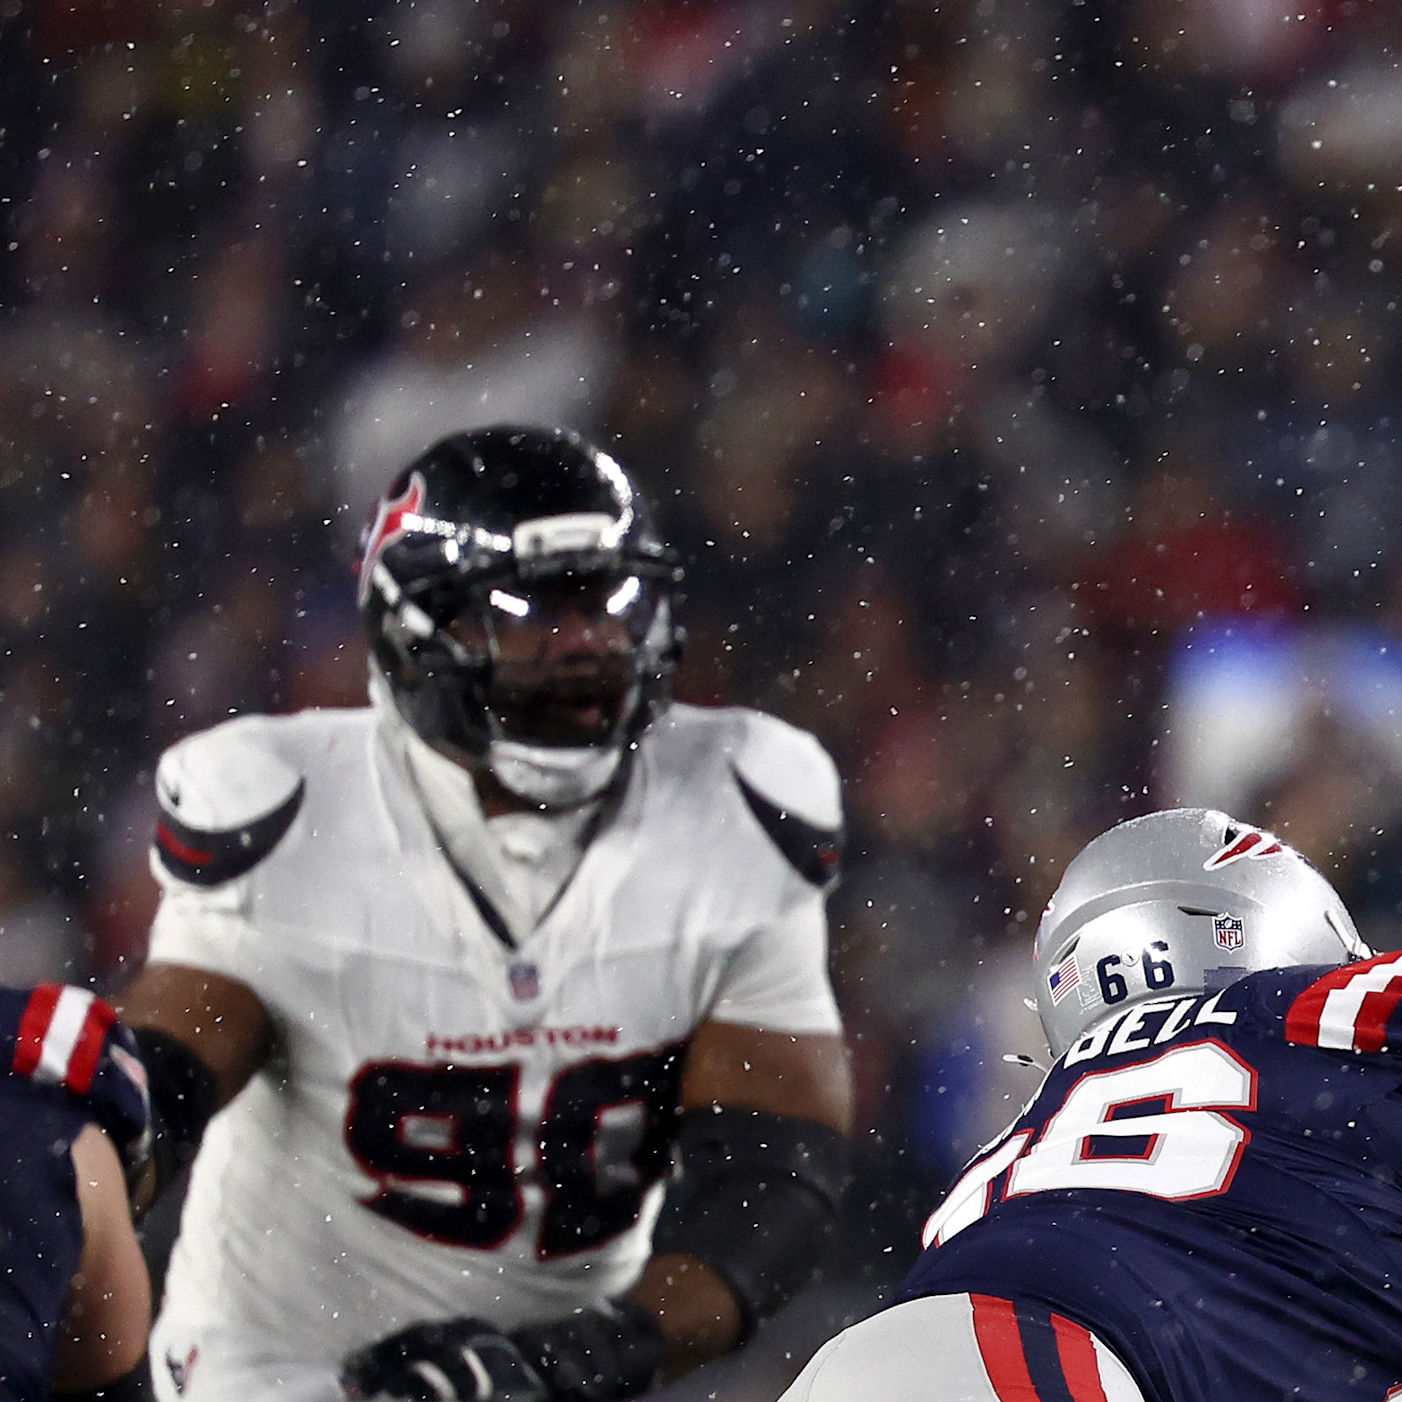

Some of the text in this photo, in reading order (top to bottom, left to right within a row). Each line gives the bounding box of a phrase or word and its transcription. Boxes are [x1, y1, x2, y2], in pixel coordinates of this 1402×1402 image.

[1219, 930, 1243, 947] NFL
[1096, 940, 1175, 1005] 66
[426, 1023, 619, 1055] HOUSTON
[344, 1038, 688, 1262] 90
